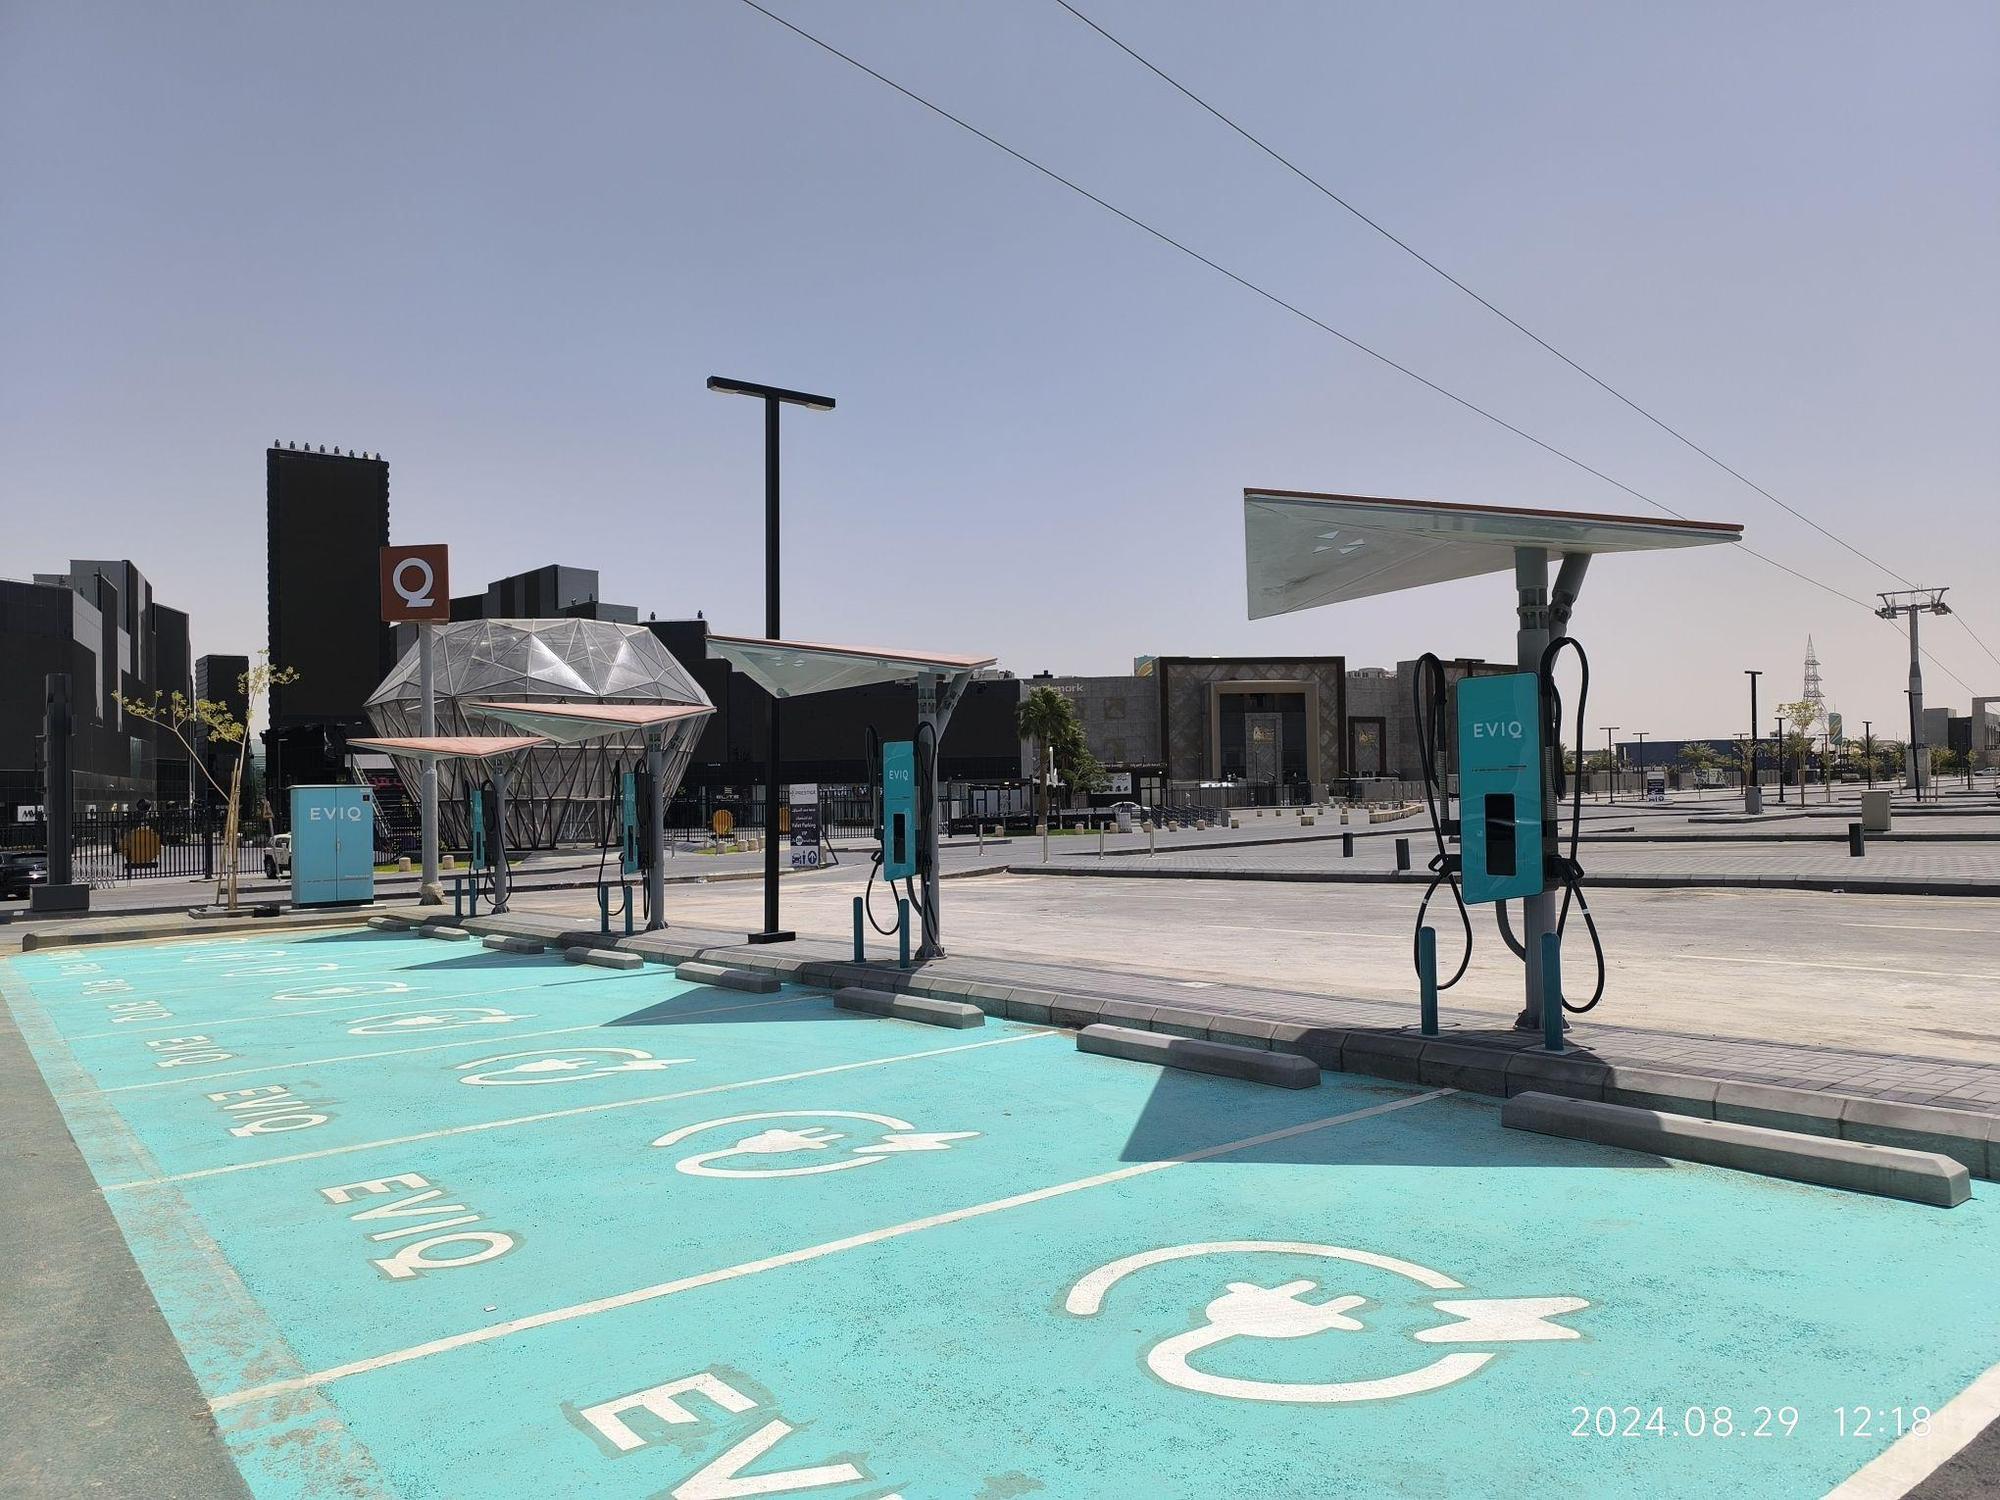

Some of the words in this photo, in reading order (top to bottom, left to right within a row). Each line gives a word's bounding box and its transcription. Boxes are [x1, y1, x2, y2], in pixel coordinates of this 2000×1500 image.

[393, 557, 435, 607] Q
[1024, 683, 1083, 692] Benmark
[1473, 721, 1522, 738] EVIQ
[889, 770, 908, 780] EVIQ
[310, 806, 361, 821] EVIQ
[146, 1035, 233, 1068] EVIQ
[207, 1085, 328, 1137] EVIQ
[319, 1172, 515, 1279] EVIQ
[579, 1372, 904, 1500] EV
